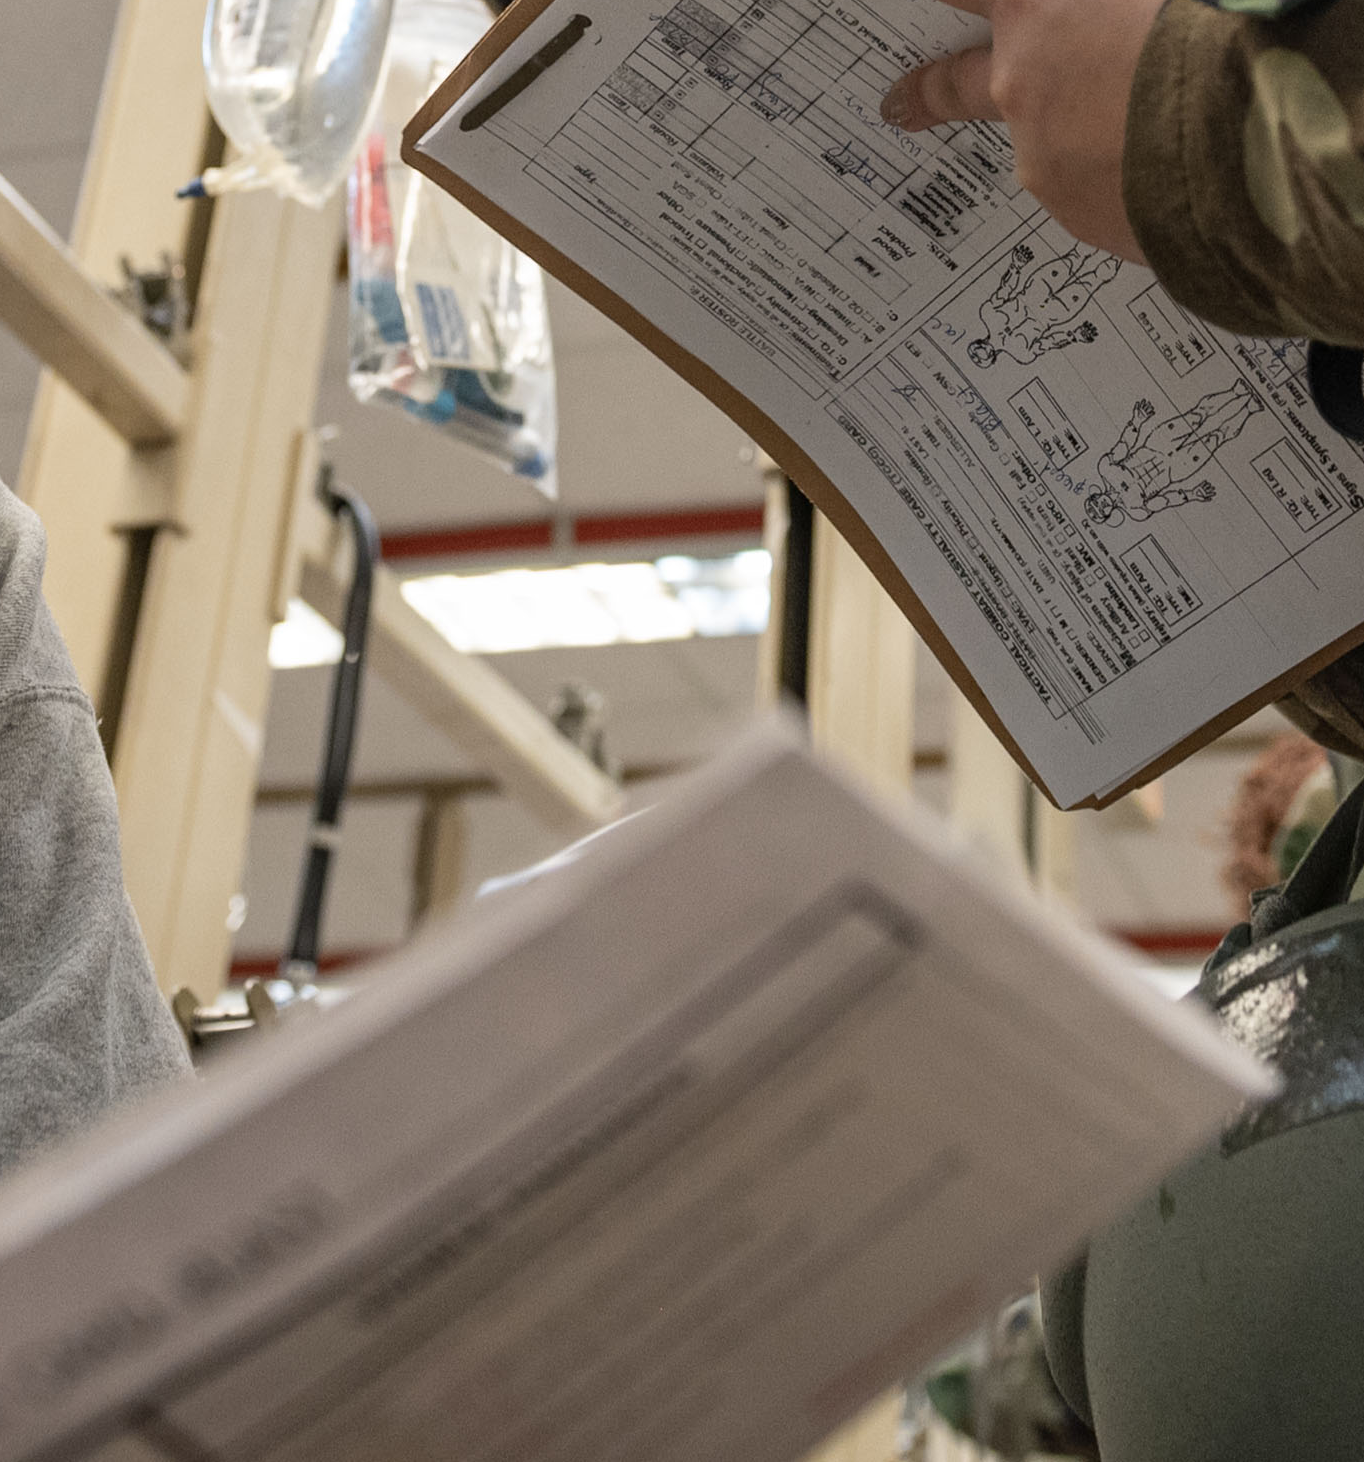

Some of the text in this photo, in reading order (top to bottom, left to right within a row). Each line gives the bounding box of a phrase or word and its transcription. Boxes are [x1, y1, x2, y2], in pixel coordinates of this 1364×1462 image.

[659, 34, 685, 57] Time
[701, 64, 733, 92] Route
[748, 98, 777, 123] Dose
[605, 90, 725, 183] Volume Route Time
[572, 162, 597, 185] Type
[818, 150, 848, 177] Name
[655, 187, 685, 214] Other
[671, 179, 696, 201] SGA
[930, 167, 979, 211] Antibiotic
[658, 210, 695, 242] Truncal
[760, 205, 789, 231] Name
[694, 217, 737, 254] Pressure
[870, 233, 904, 263] Blood
[876, 223, 917, 259] Product
[705, 247, 757, 291] Junctional
[853, 253, 881, 280] Fluid
[924, 240, 959, 272] MEDS:
[744, 257, 798, 304] Hemostatic
[792, 275, 816, 297] NPA
[697, 292, 739, 328] ROSTER
[763, 293, 809, 333] Extremity
[823, 300, 853, 327] Intact
[846, 299, 864, 316] O2
[1136, 310, 1156, 333] Leg
[736, 323, 776, 358] BATTLE
[785, 327, 843, 380] Treatments:
[1232, 342, 1257, 371] blank)
[932, 370, 957, 397] GSW
[1253, 368, 1267, 384] the
[1269, 390, 1286, 408] (Fill
[1282, 380, 1308, 408] Time
[1016, 405, 1035, 428] Arm
[908, 435, 929, 459] LAST
[1040, 437, 1057, 456] TQ:
[1282, 405, 1332, 464] Symptoms:
[901, 447, 933, 487] Routine
[1008, 468, 1027, 490] Fall
[1261, 467, 1281, 489] Leg
[938, 497, 970, 537] Priority
[1033, 504, 1056, 531] Burn
[1285, 498, 1303, 519] TQ:
[1009, 449, 1141, 630] Landmine MVC RPG Other:
[836, 412, 1054, 704] TACTICAL COMBAT CASUALTY CARE (TCCC) CARD
[976, 550, 1005, 588] Urgent
[1063, 546, 1087, 575] Blunt
[1023, 568, 1044, 594] DATE
[1057, 559, 1086, 593] Injury:
[1127, 561, 1147, 584] Arm
[1080, 591, 1093, 605] of
[1151, 593, 1169, 614] TQ:
[1097, 594, 1131, 636] Artillery
[1140, 603, 1172, 643] Injury:
[1088, 602, 1138, 667] Mechanism
[1072, 639, 1108, 684] GENDER:
[1085, 629, 1121, 675] SERVICE:
[1070, 663, 1095, 693] NAME
